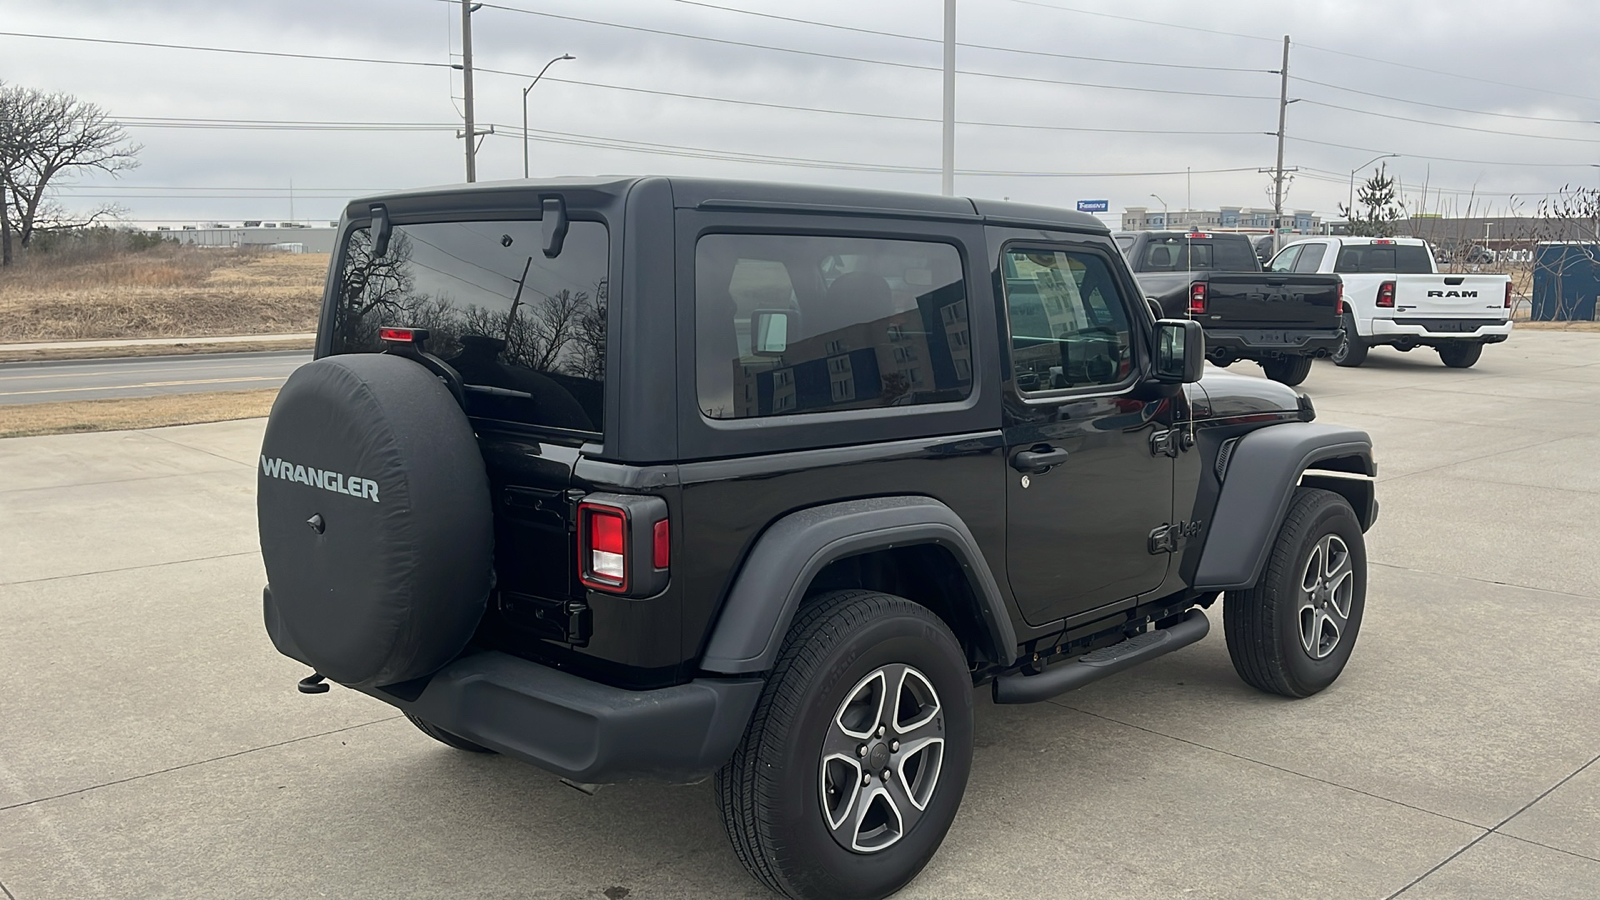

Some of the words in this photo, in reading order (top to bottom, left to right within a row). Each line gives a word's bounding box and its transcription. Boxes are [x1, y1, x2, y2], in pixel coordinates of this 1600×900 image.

[1246, 291, 1304, 303] RAM
[1427, 290, 1478, 298] RAM
[261, 454, 380, 503] WRANGLER
